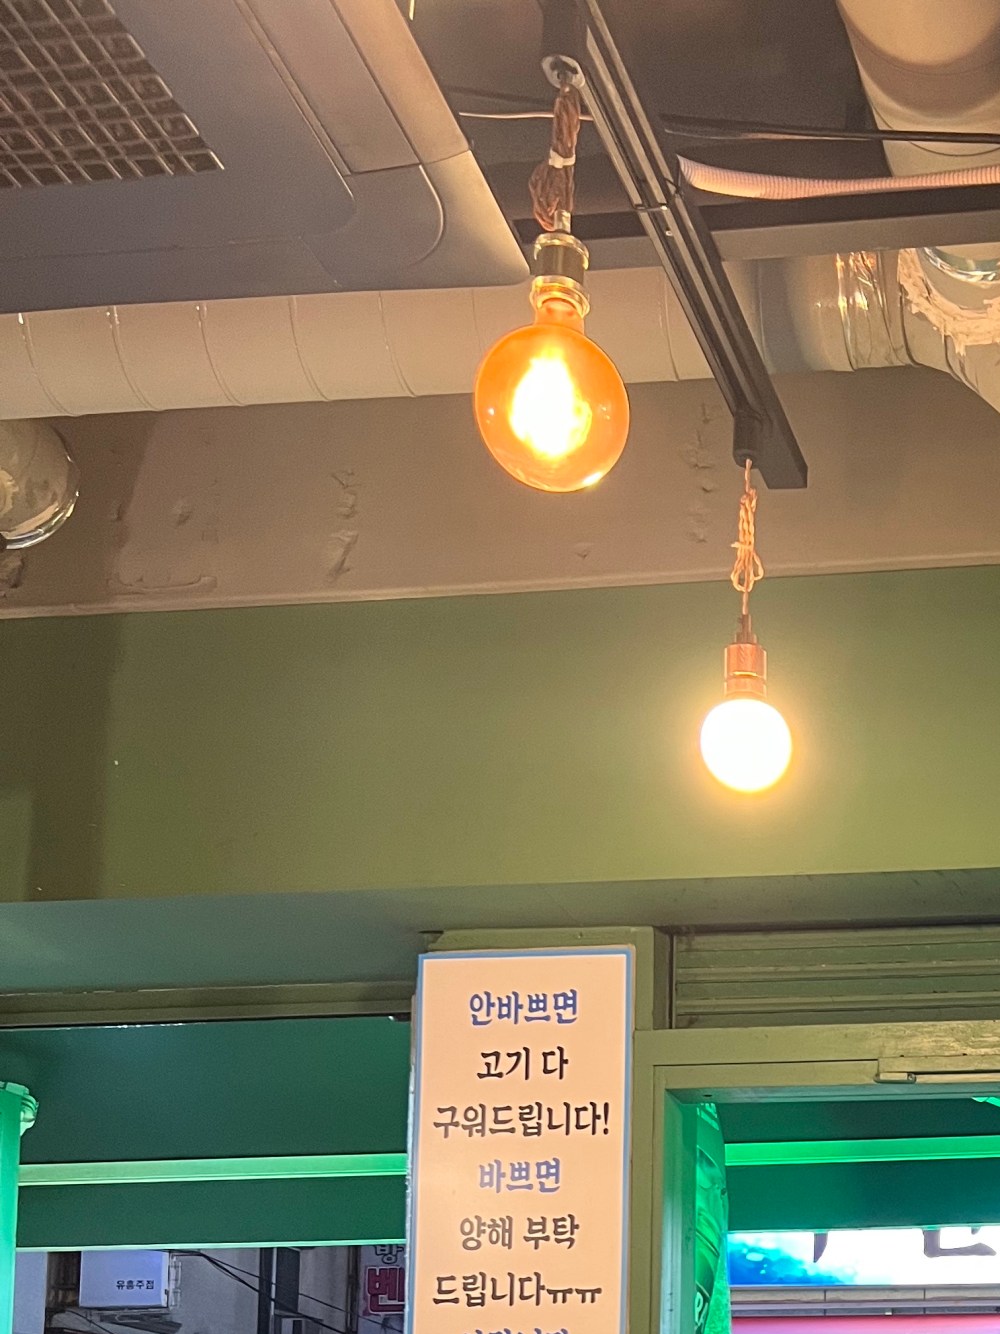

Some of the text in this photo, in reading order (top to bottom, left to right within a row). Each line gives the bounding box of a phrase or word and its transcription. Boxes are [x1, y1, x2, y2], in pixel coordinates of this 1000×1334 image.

[469, 989, 579, 1026] 안바쁘면
[476, 1046, 569, 1081] 고기 다
[432, 1101, 611, 1139] 구워드립니다!
[478, 1157, 561, 1194] 바쁘면
[459, 1214, 580, 1251] 양해 부탁
[116, 1279, 155, 1290] 유흥주점
[432, 1270, 602, 1307] 드립니다ㅠㅠ
